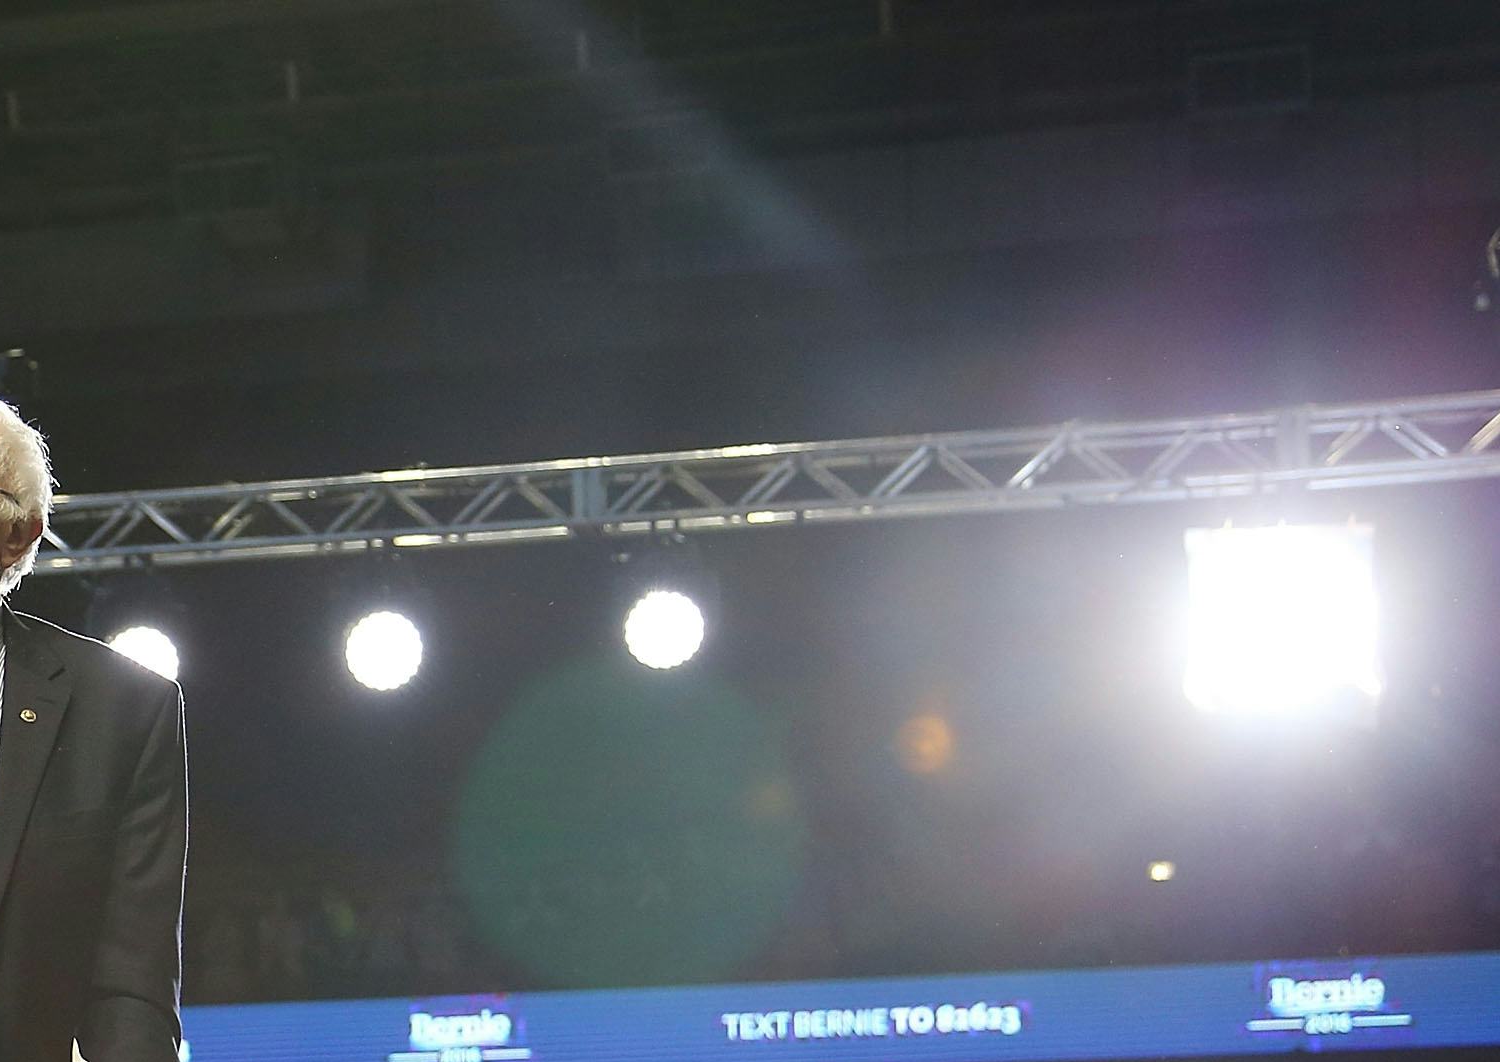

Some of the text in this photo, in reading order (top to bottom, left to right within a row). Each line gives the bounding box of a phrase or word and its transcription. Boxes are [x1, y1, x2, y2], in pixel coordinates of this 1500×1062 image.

[721, 1012, 790, 1040] TEXT
[794, 1008, 889, 1037] BERNIE
[890, 1005, 934, 1034] TO
